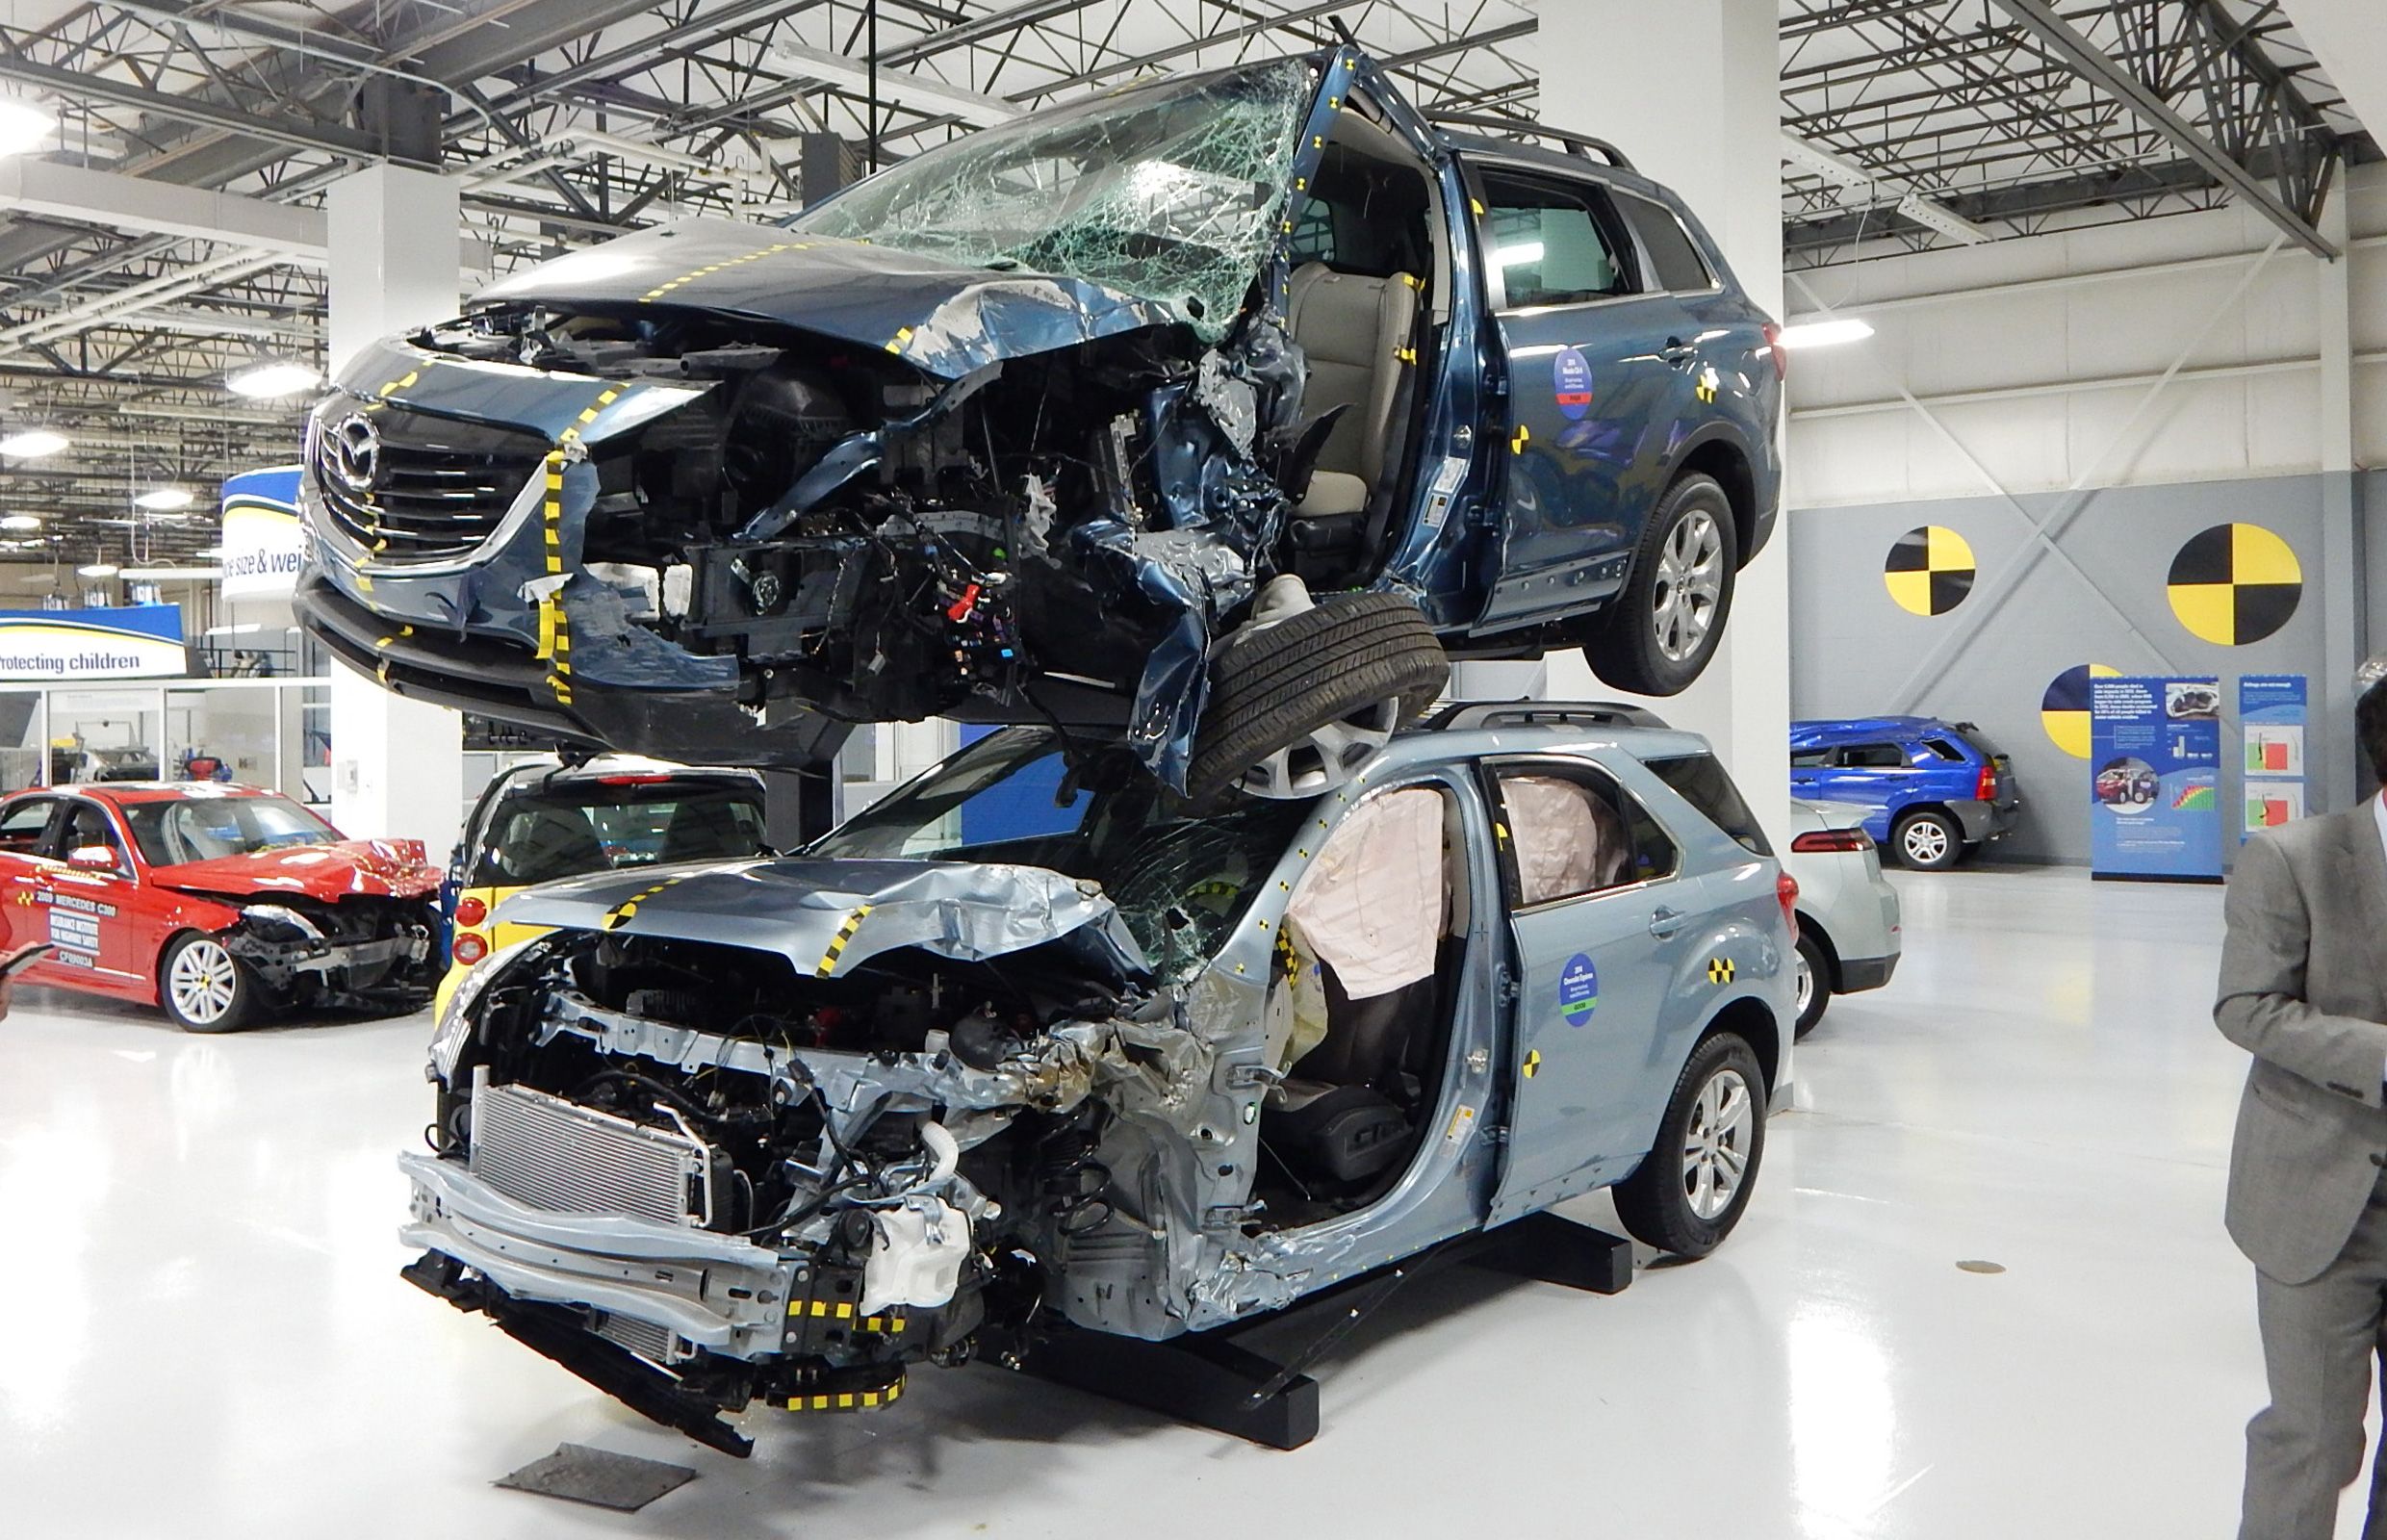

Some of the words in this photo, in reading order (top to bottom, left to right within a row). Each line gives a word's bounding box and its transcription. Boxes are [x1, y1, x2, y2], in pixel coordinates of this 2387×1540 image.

[236, 550, 255, 576] size
[257, 548, 267, 574] &
[0, 653, 64, 674] rotecting
[68, 652, 141, 670] children
[55, 893, 95, 912] MERCEDES
